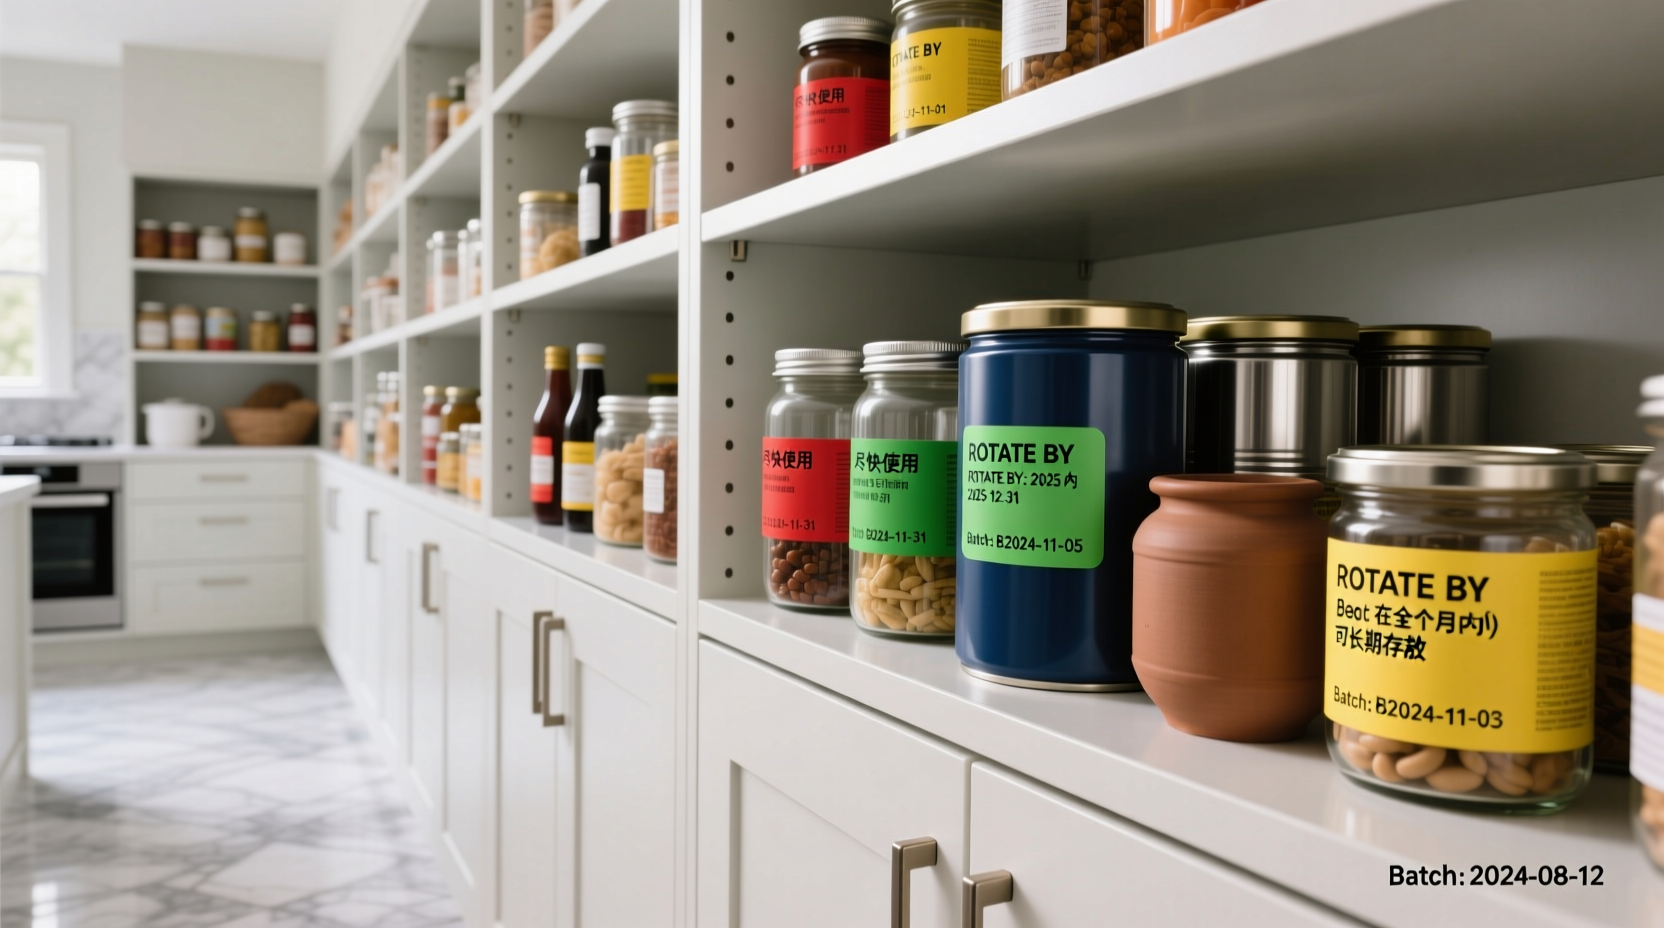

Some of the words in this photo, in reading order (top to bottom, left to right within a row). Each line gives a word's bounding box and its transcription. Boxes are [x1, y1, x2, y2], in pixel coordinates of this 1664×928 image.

[923, 41, 942, 57] BY
[969, 442, 1036, 463] ROTATE
[1043, 443, 1075, 464] BY
[1007, 471, 1028, 485] BY:
[1030, 472, 1061, 487] 2025
[996, 534, 1084, 553] B2024-11-05
[1337, 564, 1435, 600] ROTATE
[1446, 575, 1490, 602] BY
[1334, 685, 1372, 712] Batch:
[1375, 695, 1504, 729] B2024-11-03
